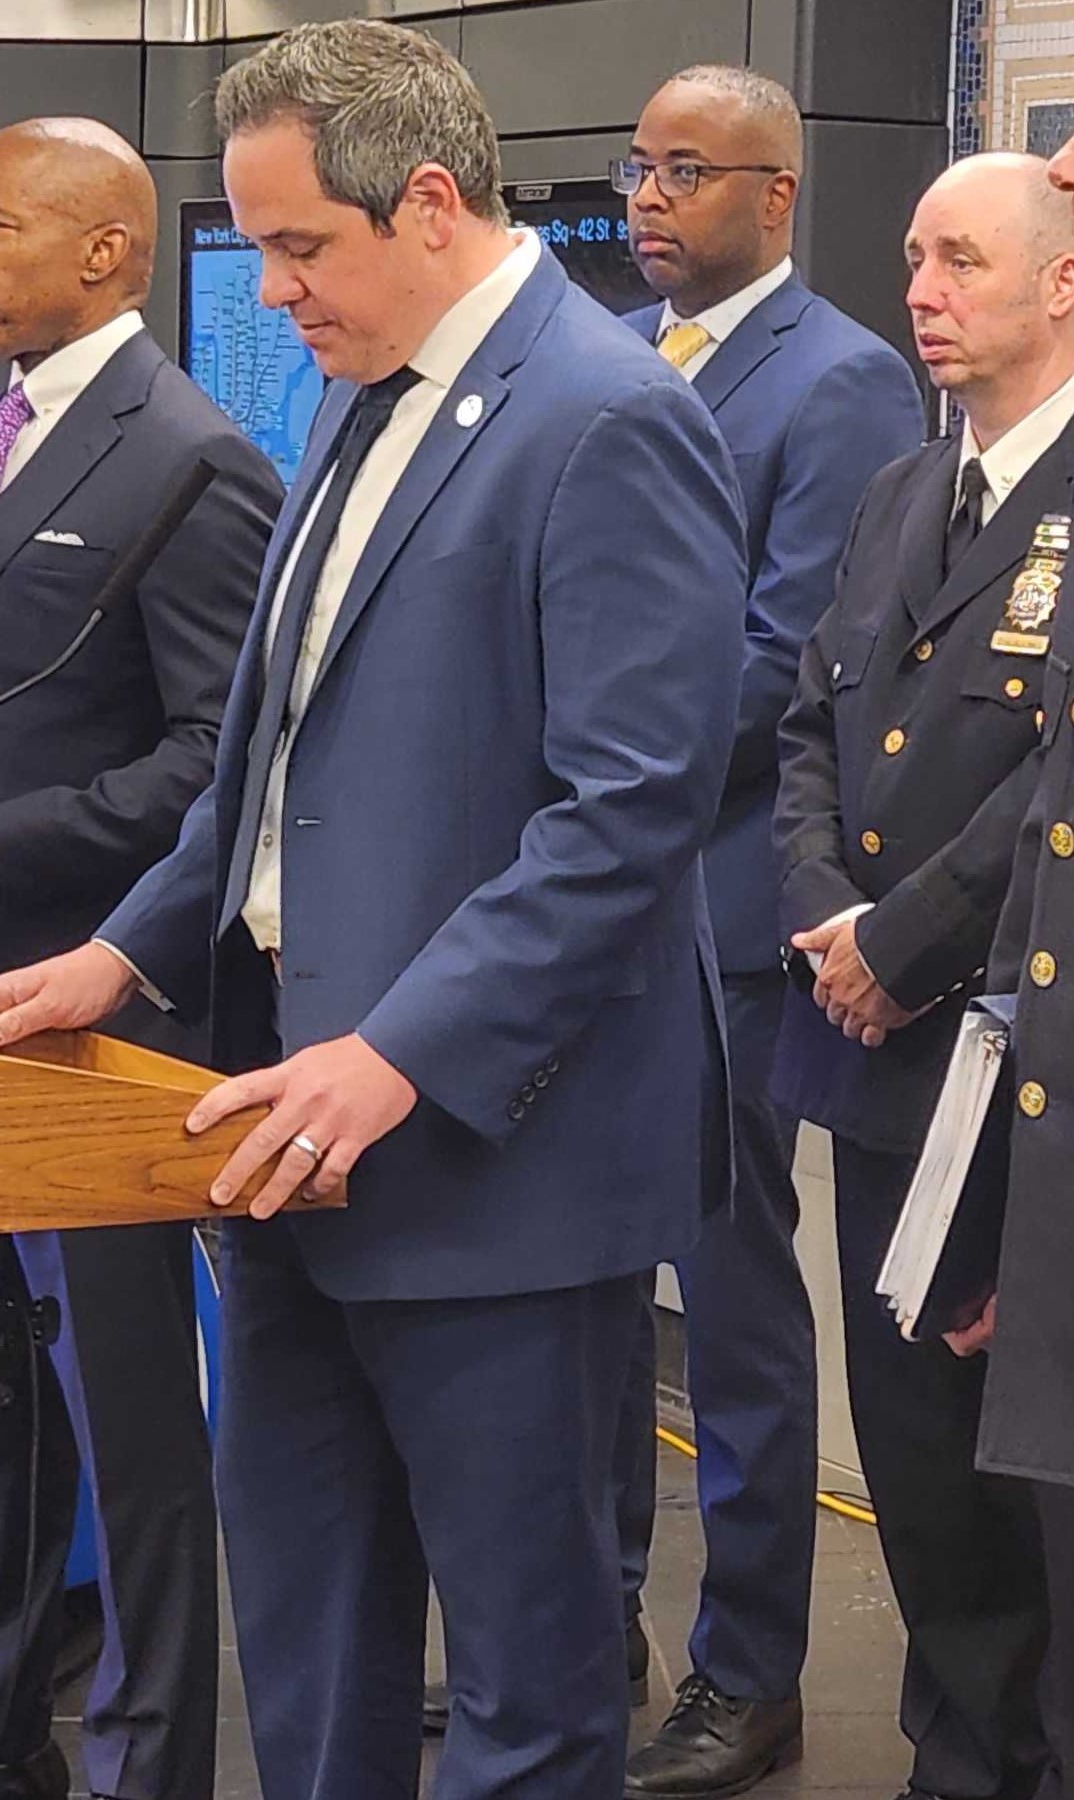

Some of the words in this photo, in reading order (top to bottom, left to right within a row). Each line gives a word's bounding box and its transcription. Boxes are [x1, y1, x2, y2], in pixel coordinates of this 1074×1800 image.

[552, 219, 568, 248] Sq
[577, 217, 595, 241] 42
[595, 217, 610, 241] St
